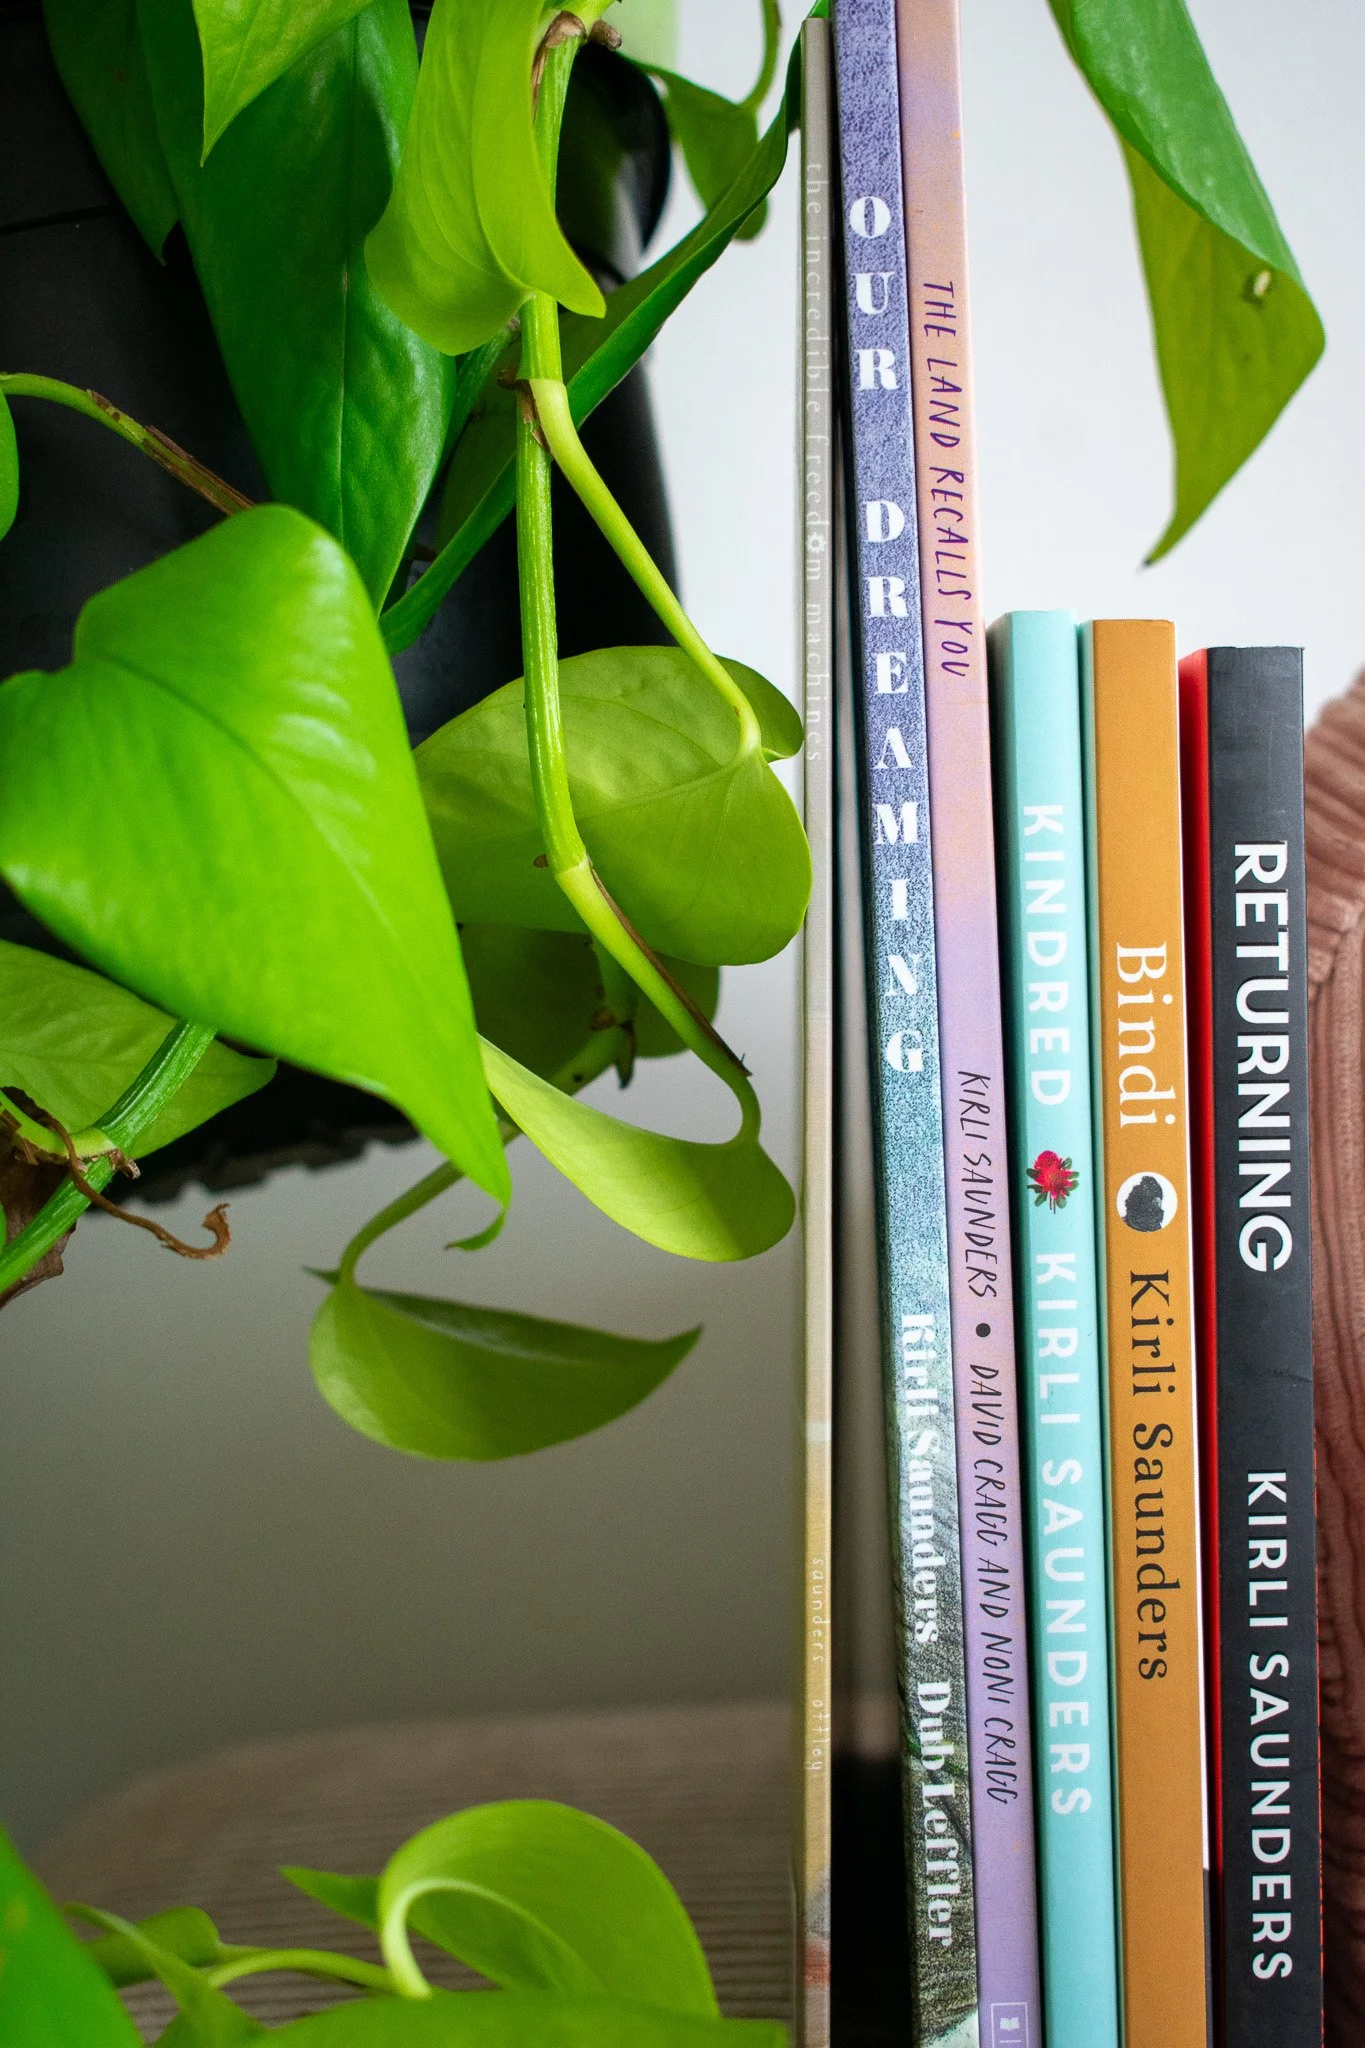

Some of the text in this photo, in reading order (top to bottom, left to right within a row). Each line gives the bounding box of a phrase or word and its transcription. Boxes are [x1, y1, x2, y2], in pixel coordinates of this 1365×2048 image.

[806, 163, 830, 214] the
[806, 236, 830, 414] incredible
[850, 196, 924, 1073] OUR DREAMING
[923, 281, 974, 677] THE LAND RECALLS YOU
[806, 603, 830, 762] machines
[1023, 804, 1071, 1106] KINDRED
[1116, 941, 1177, 1128] Bindi
[1234, 840, 1293, 1273] RETURNING
[957, 1071, 999, 1299] KIRLI SAUNDERS
[812, 1558, 831, 1663] saunders
[901, 1313, 947, 1644] Kirli Saunders
[969, 1363, 1019, 1805] DAVID CRAGG AND NONI CRAGG
[1034, 1252, 1093, 1816] KIRLI SAUNDERS
[1130, 1269, 1181, 1681] Kirli Saunders
[917, 1680, 961, 1948] Dub Leffler
[1247, 1471, 1293, 1980] KIRLI SAUNDERS
